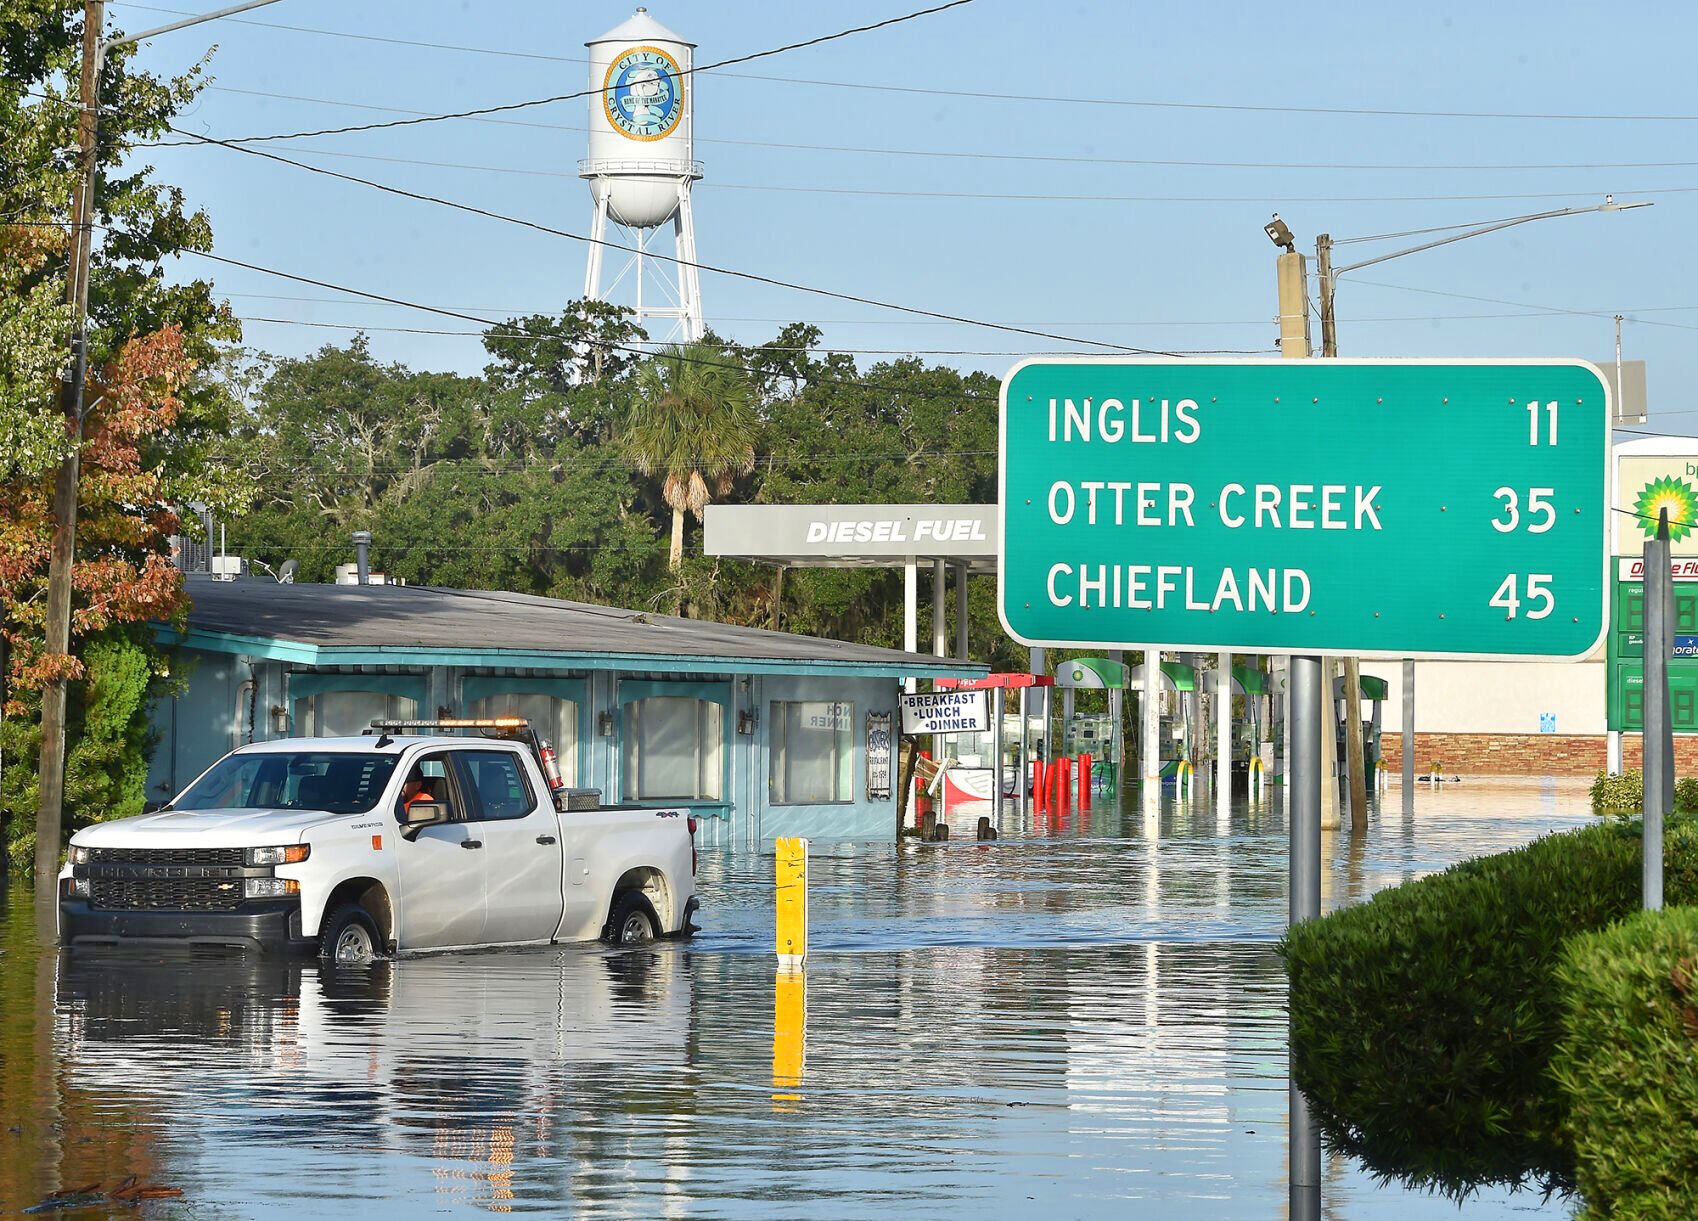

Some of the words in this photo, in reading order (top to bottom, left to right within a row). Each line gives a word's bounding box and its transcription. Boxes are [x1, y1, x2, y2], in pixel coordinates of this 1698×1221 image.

[619, 53, 649, 70] CITY
[656, 57, 672, 70] OF
[608, 97, 652, 135] CRYSTAL
[657, 98, 681, 132] RIVER
[1049, 397, 1201, 444] INGLIS
[1527, 401, 1558, 446] 11
[1048, 481, 1195, 527] OTTER
[1219, 483, 1383, 530] CREEK
[1492, 487, 1556, 533] 35
[807, 521, 906, 543] DIESEL
[913, 520, 986, 541] FUEL
[1047, 563, 1311, 613] CHIEFLAND
[1489, 574, 1555, 620] 45
[909, 694, 976, 707] BREAKFAST
[919, 707, 960, 719] LUNCH
[931, 718, 976, 730] DINNER
